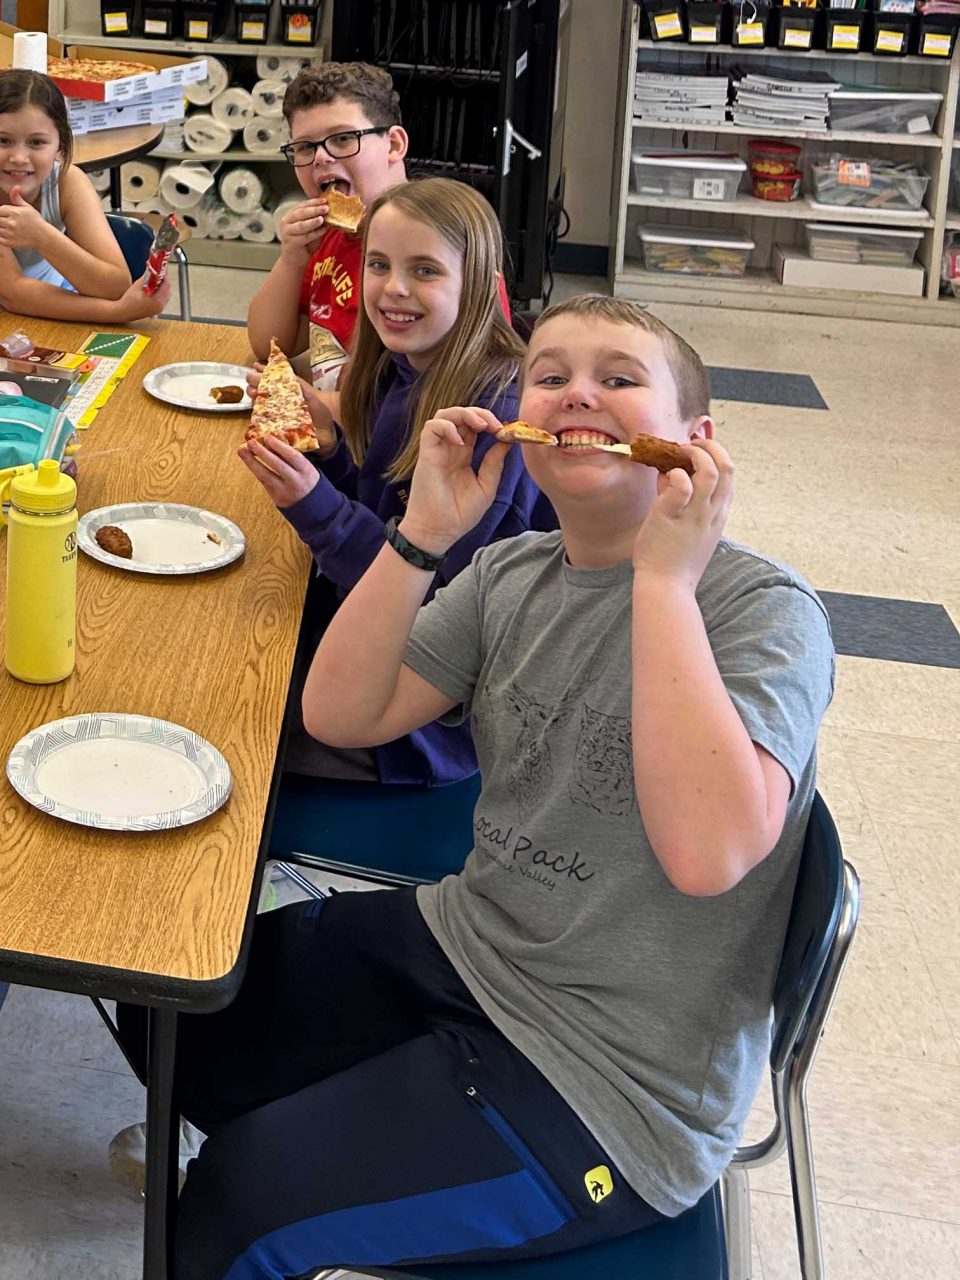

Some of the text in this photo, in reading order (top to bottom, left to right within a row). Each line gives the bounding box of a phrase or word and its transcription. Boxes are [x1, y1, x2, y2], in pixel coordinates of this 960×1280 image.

[475, 817, 513, 850] ocal
[513, 835, 595, 882] Pack
[519, 866, 556, 891] Valley
